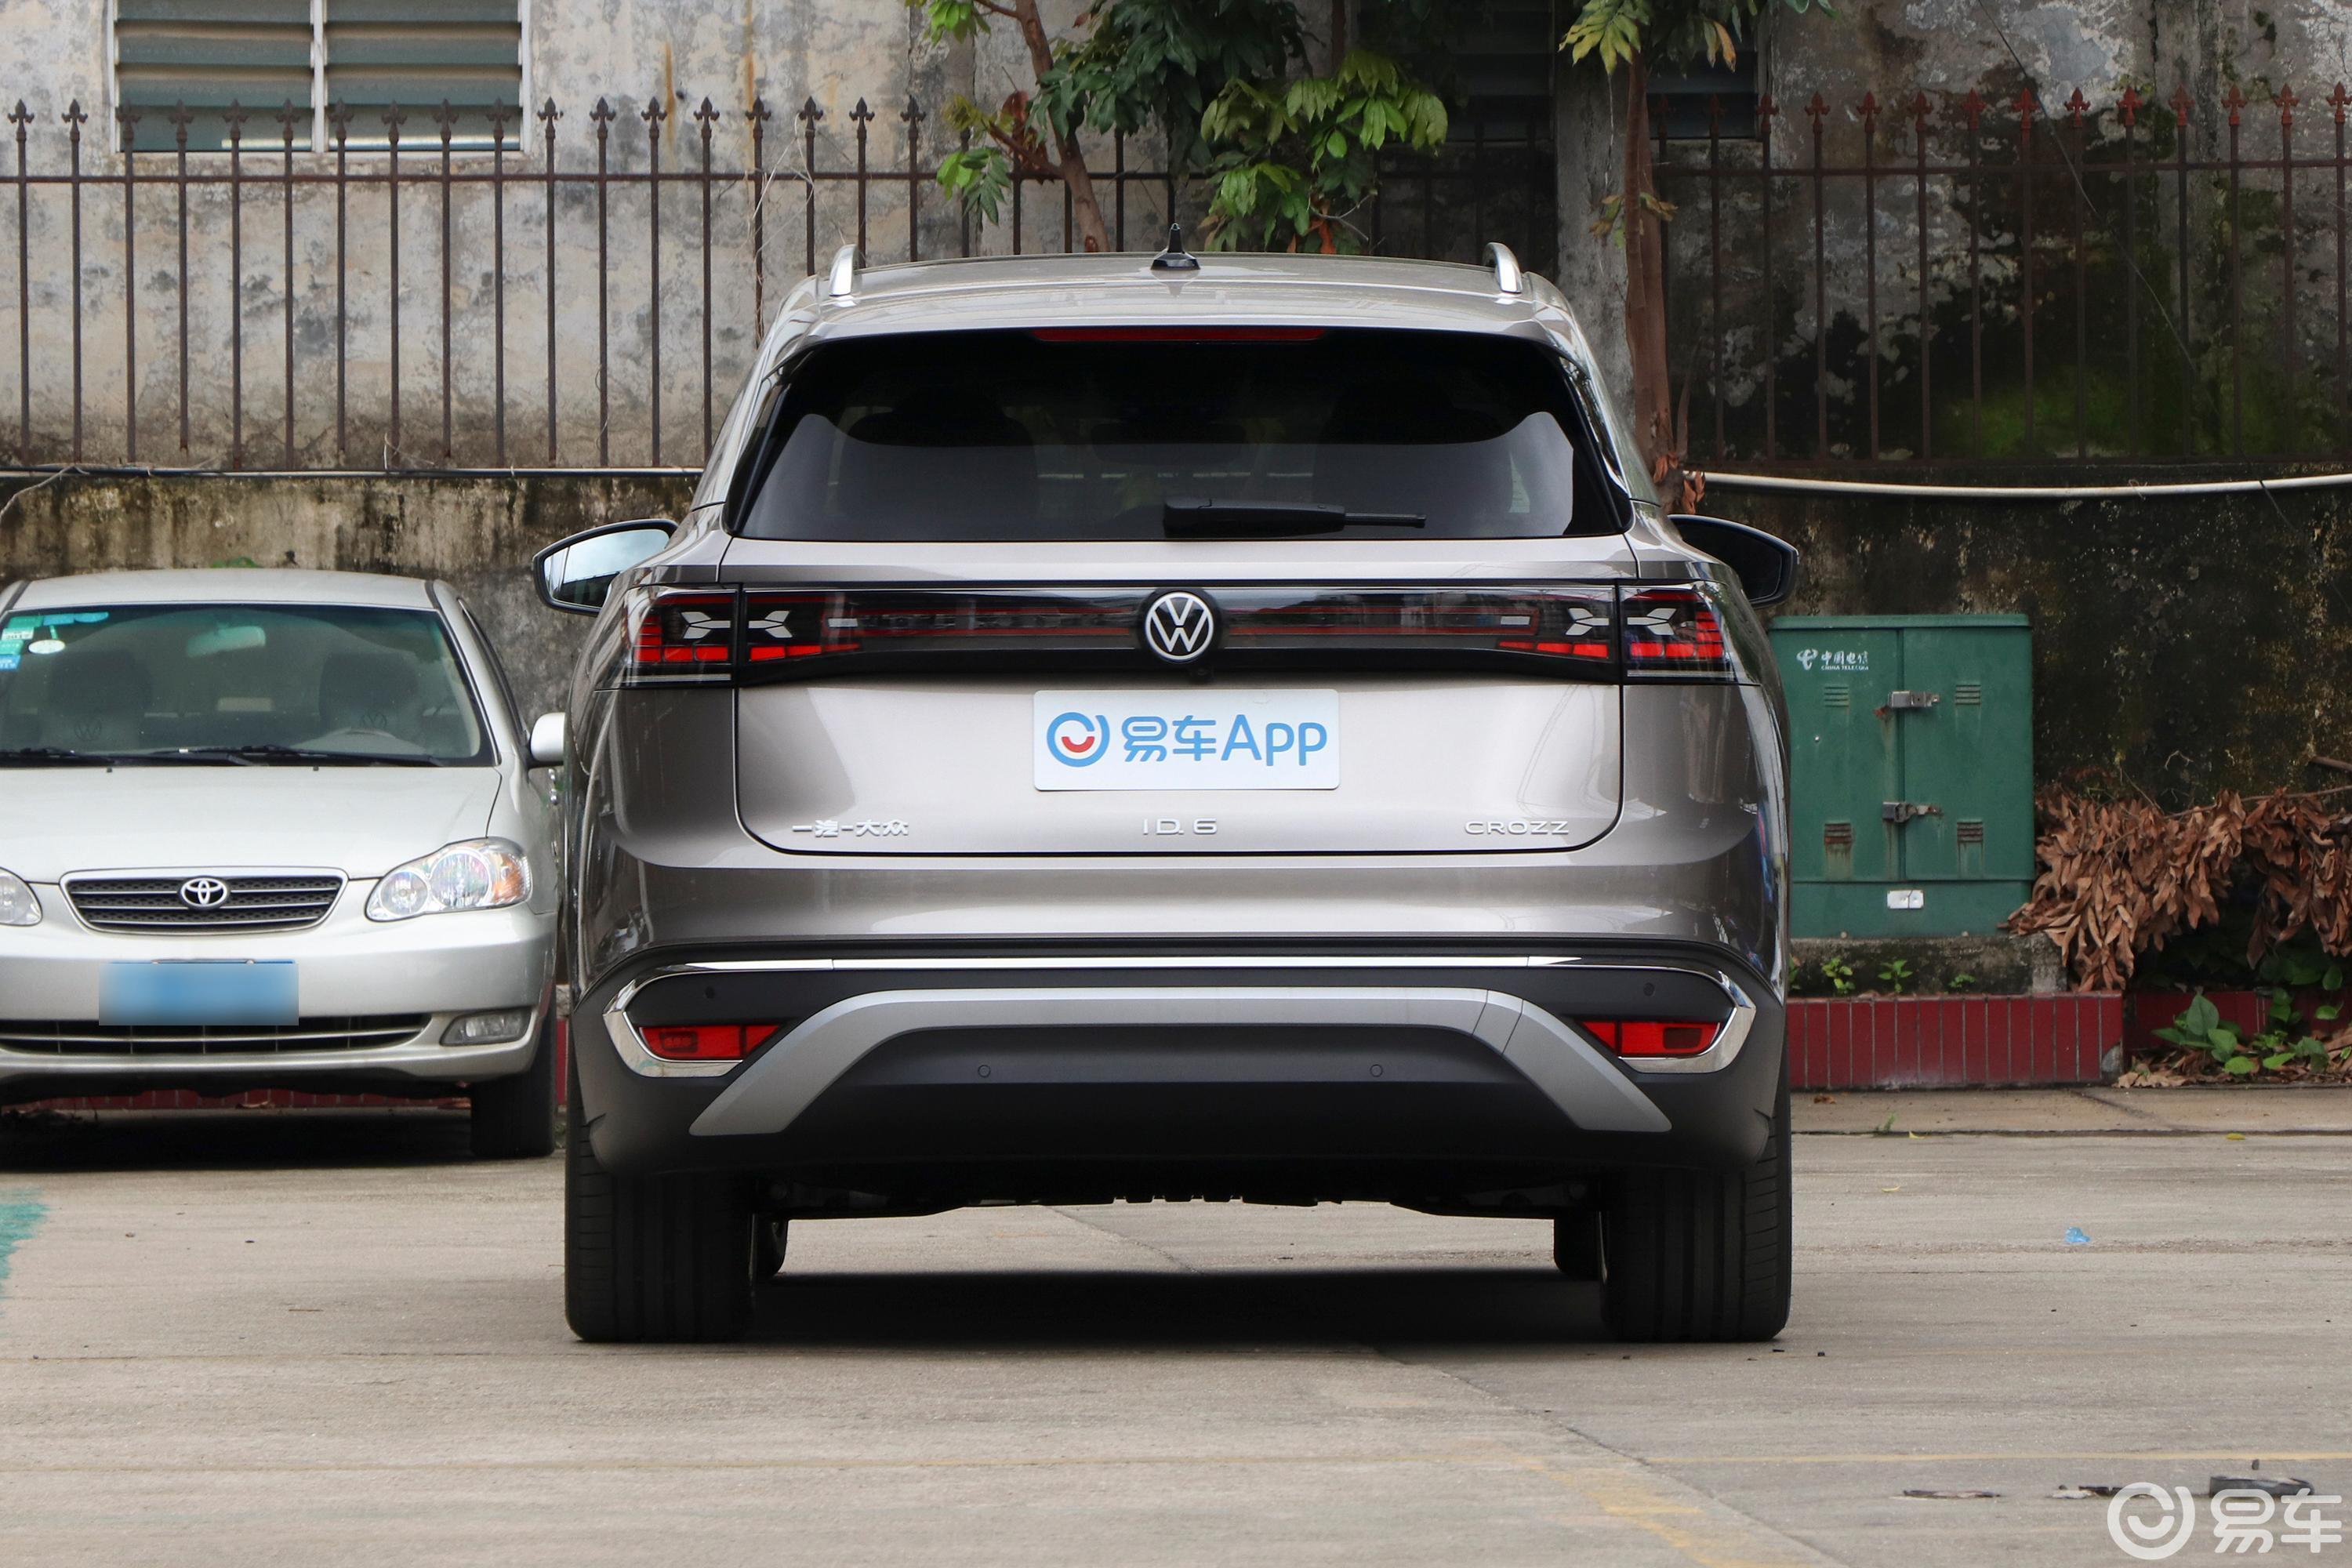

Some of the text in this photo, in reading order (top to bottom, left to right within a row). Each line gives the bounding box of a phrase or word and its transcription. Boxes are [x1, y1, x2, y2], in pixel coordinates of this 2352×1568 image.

[1820, 650, 1868, 665] 中国电信
[1465, 821, 1569, 834] CROZZ
